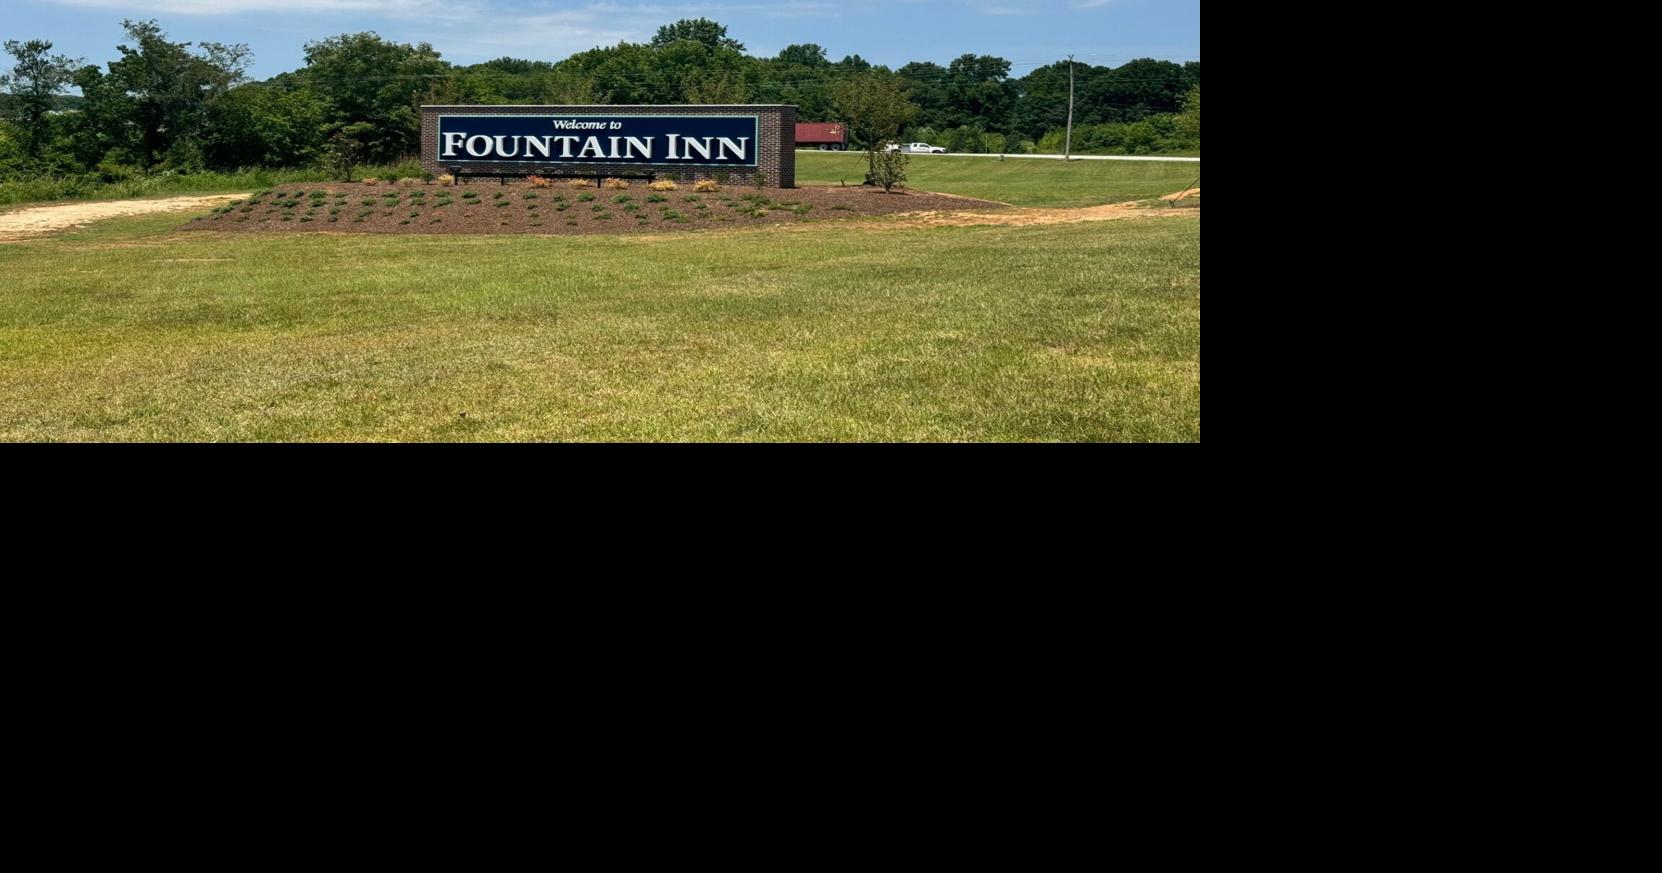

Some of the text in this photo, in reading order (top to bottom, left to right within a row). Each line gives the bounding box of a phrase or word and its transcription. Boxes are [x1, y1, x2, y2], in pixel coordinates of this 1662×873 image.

[553, 119, 622, 130] Welcome to
[442, 132, 749, 160] FOUNTAIN INN
